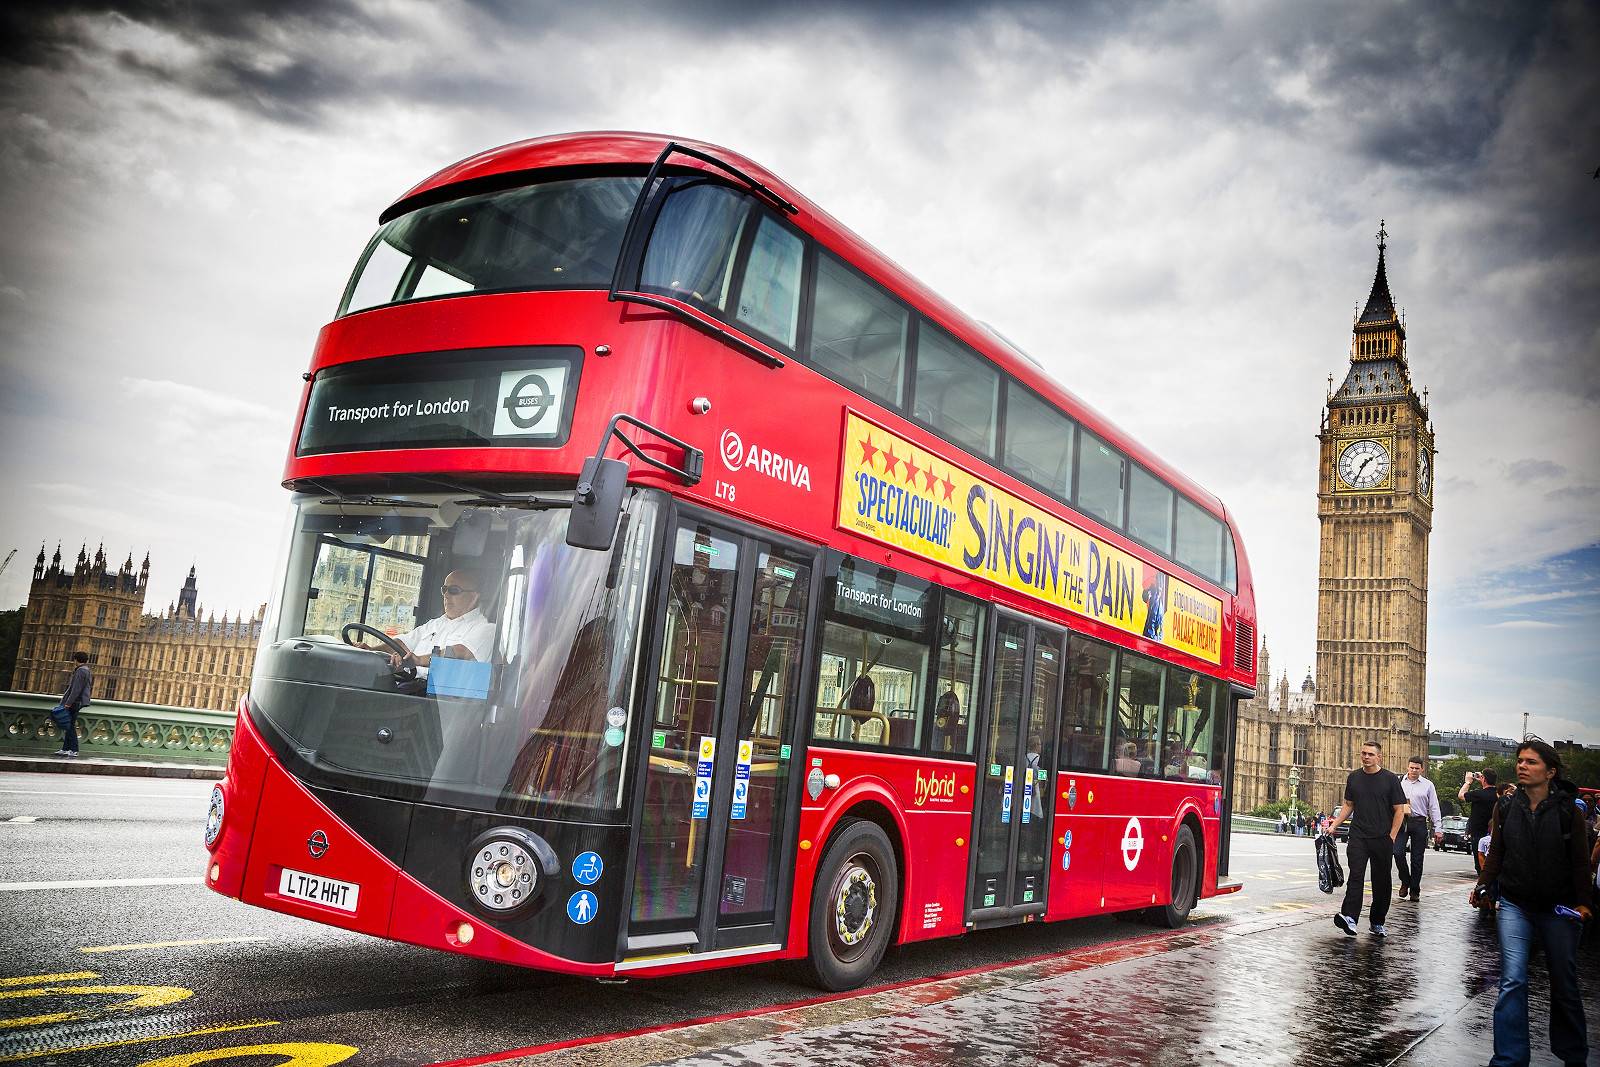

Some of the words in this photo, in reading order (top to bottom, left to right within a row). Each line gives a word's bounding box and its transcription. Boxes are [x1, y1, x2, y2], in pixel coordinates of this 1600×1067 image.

[328, 402, 389, 423] Transport
[393, 400, 413, 417] for
[416, 397, 469, 416] London
[519, 397, 539, 406] BUSES
[745, 445, 811, 492] ARRIVA
[715, 480, 736, 502] LT8
[1070, 539, 1080, 567] IN
[1063, 571, 1083, 606] THE
[1086, 540, 1135, 624] RAIN
[836, 581, 878, 607] Transport
[879, 594, 893, 610] for
[893, 597, 922, 619] London
[1172, 611, 1195, 646] PALACE
[914, 769, 956, 806] hybrid
[287, 873, 318, 899] LT12
[321, 881, 350, 905] HHT
